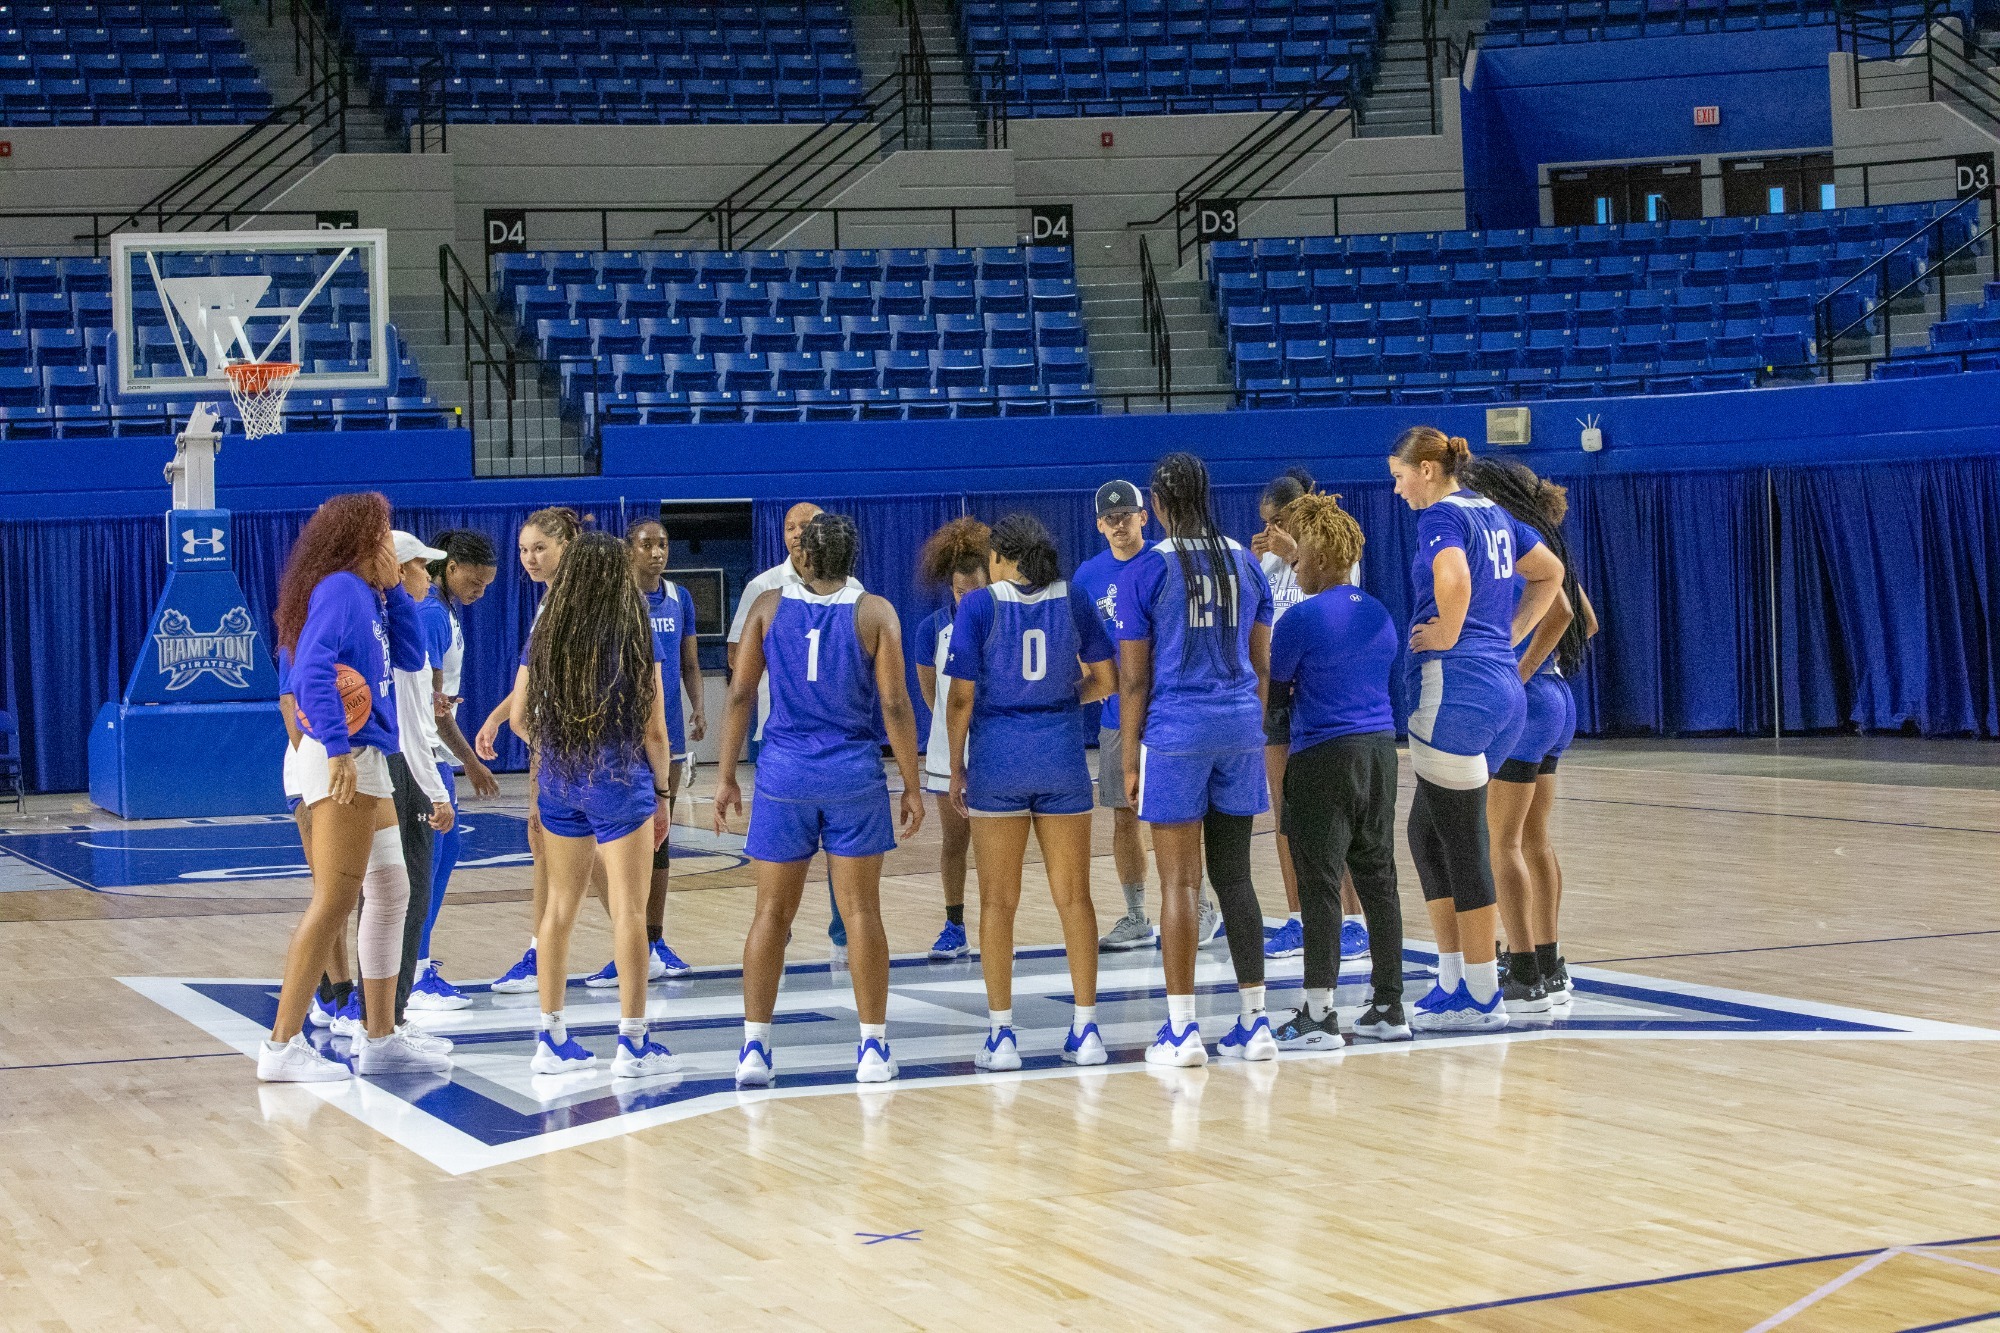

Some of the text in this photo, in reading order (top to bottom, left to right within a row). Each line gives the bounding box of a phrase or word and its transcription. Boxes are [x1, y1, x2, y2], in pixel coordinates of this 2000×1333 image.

[1696, 108, 1717, 124] EXIT
[1957, 164, 1989, 191] D3
[489, 220, 525, 244] D4
[1033, 215, 1069, 239] D4
[1201, 209, 1236, 234] D3
[1482, 528, 1513, 580] 43
[650, 617, 675, 633] ATES
[161, 636, 249, 668] HAMPTON
[804, 628, 821, 682] 1
[1022, 628, 1047, 681] 0
[180, 660, 235, 671] PIRATES
